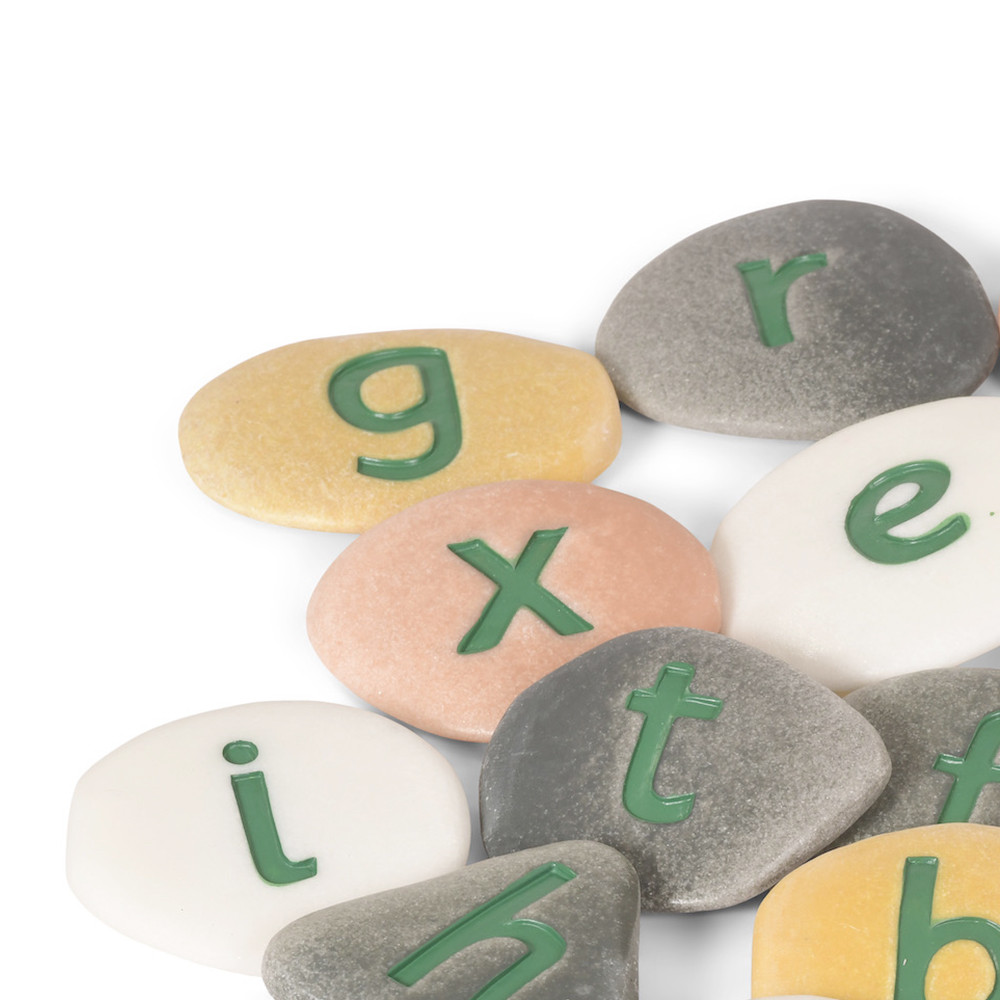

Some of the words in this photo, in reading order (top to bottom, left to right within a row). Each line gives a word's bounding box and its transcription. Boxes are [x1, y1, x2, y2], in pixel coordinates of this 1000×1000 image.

[736, 252, 827, 347] r
[327, 346, 462, 480] g
[844, 459, 971, 565] e
[446, 526, 594, 654] x
[622, 661, 724, 824] t
[222, 740, 317, 886] i
